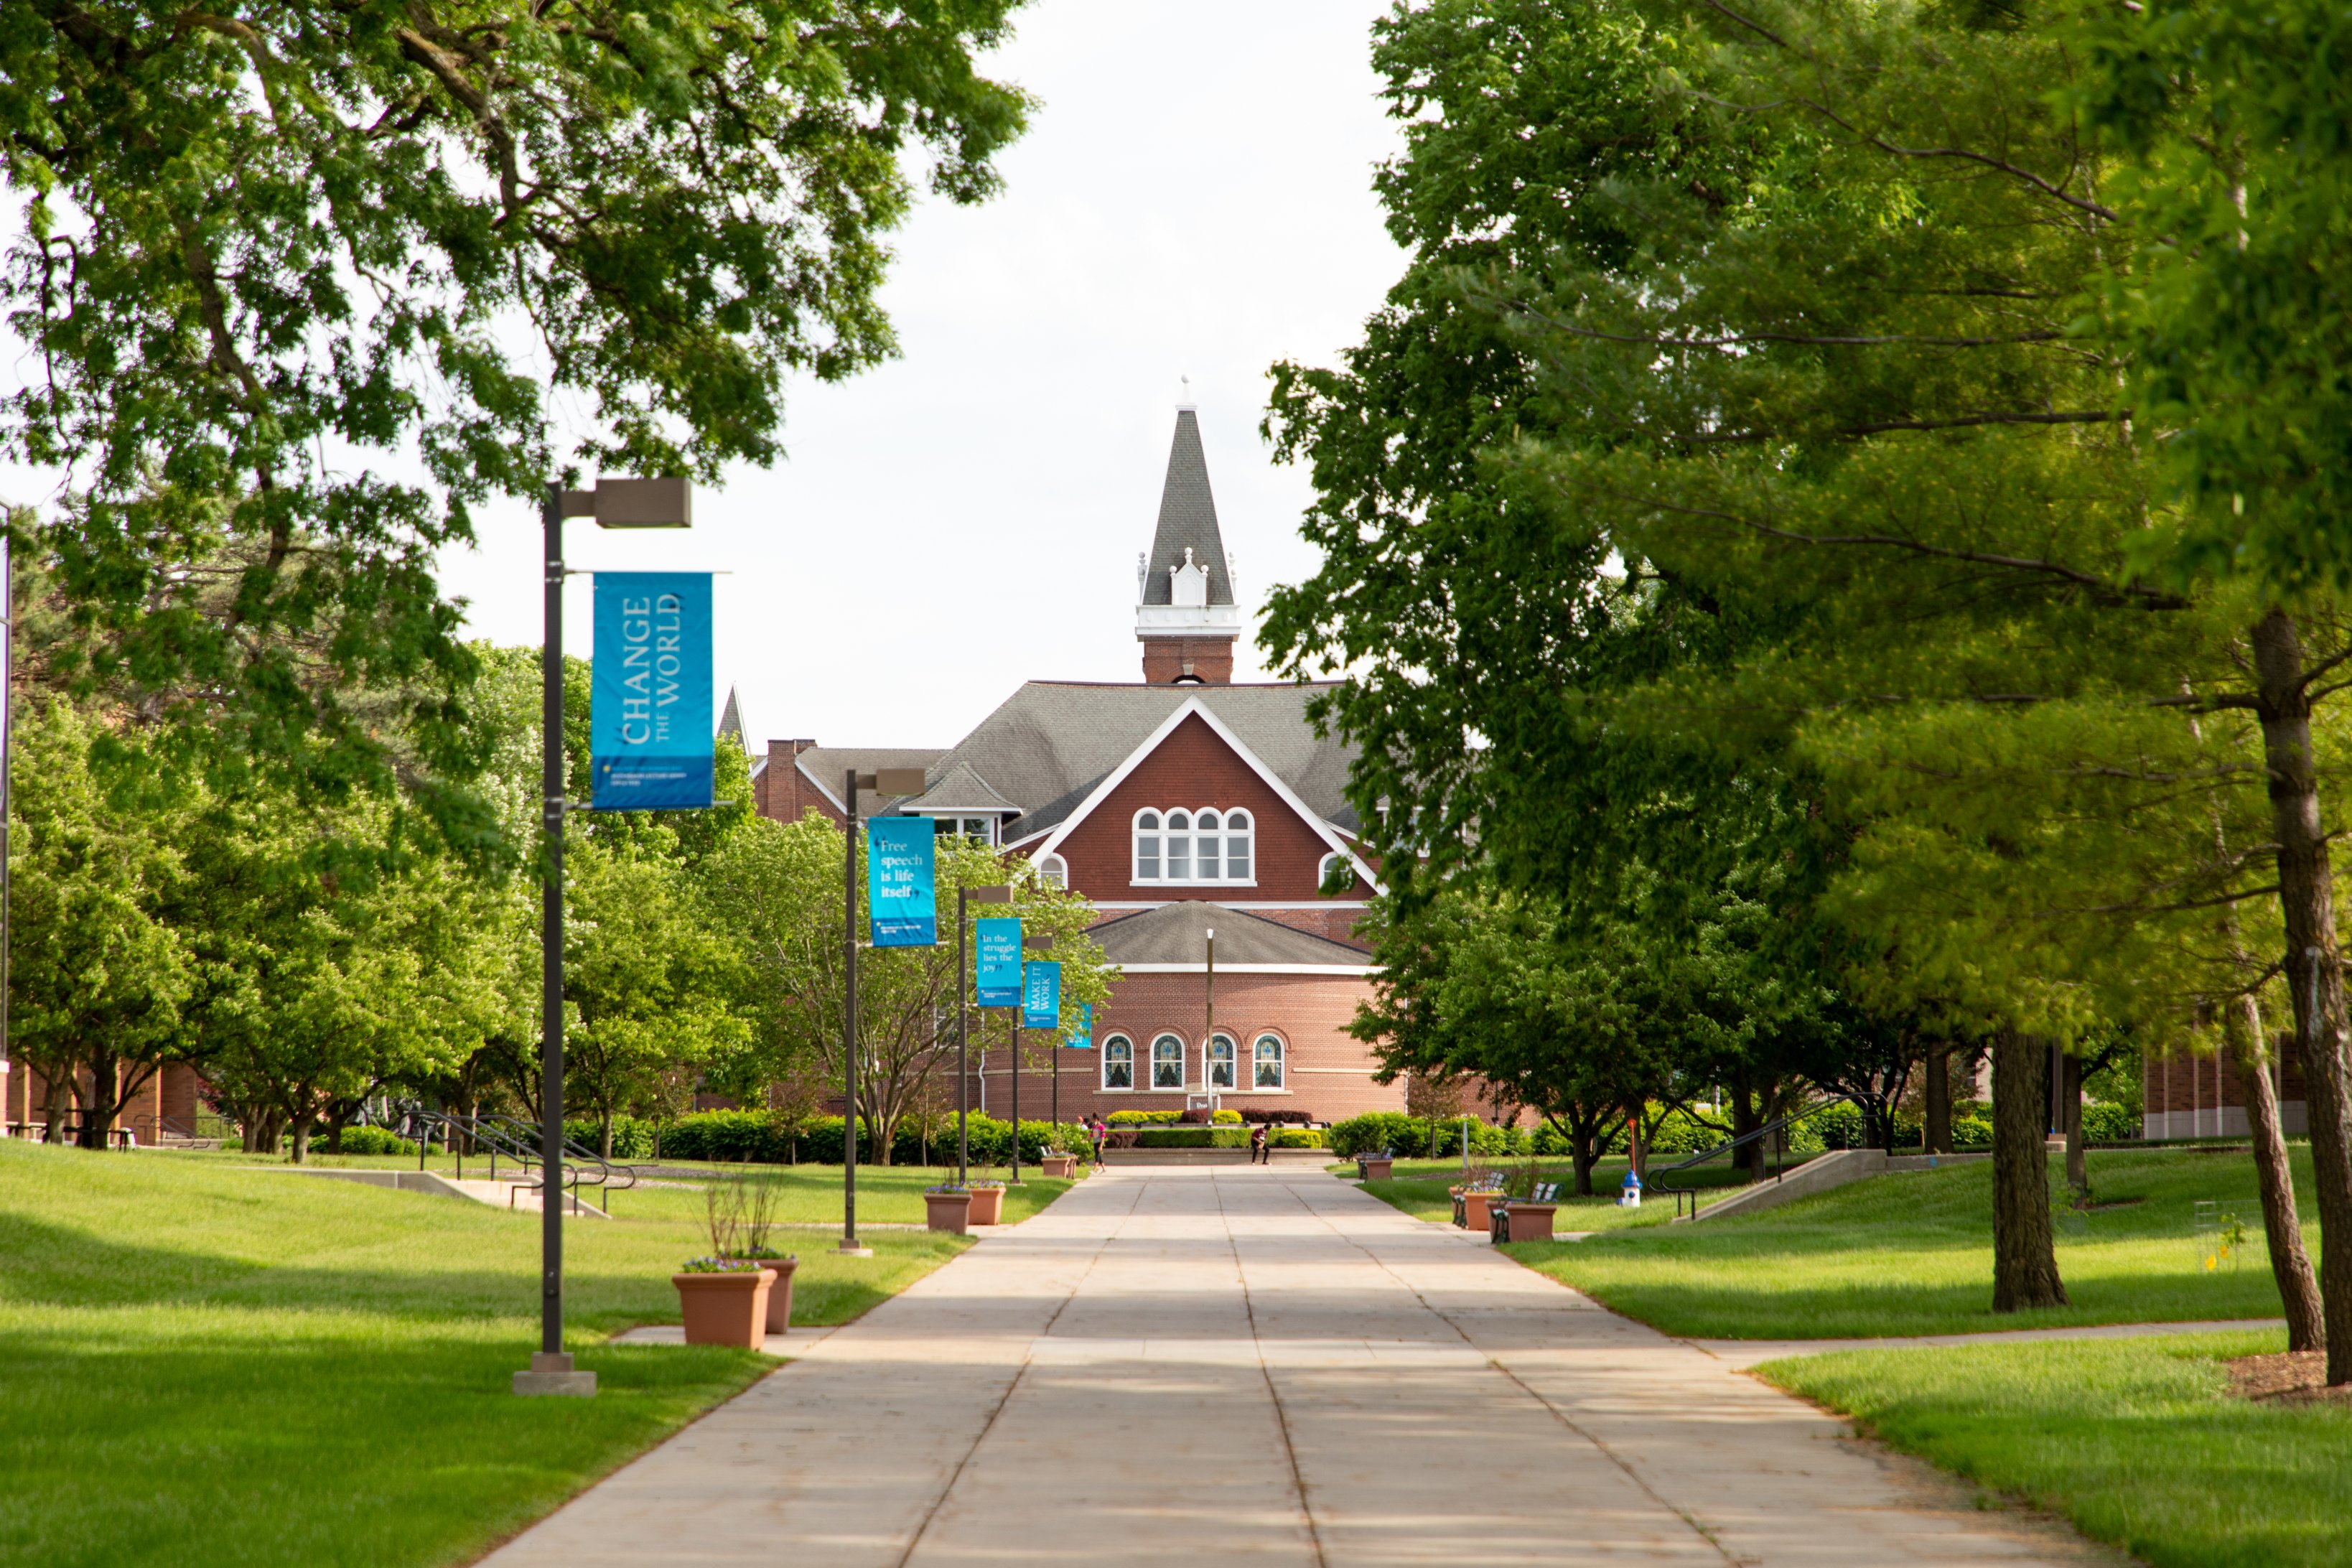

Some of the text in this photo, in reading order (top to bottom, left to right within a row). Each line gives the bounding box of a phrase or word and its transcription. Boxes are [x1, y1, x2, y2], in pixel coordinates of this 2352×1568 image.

[656, 711, 669, 742] THE
[881, 854, 923, 869] speech
[881, 869, 914, 882] is life
[983, 943, 1016, 953] struggle
[1032, 966, 1040, 976] IT
